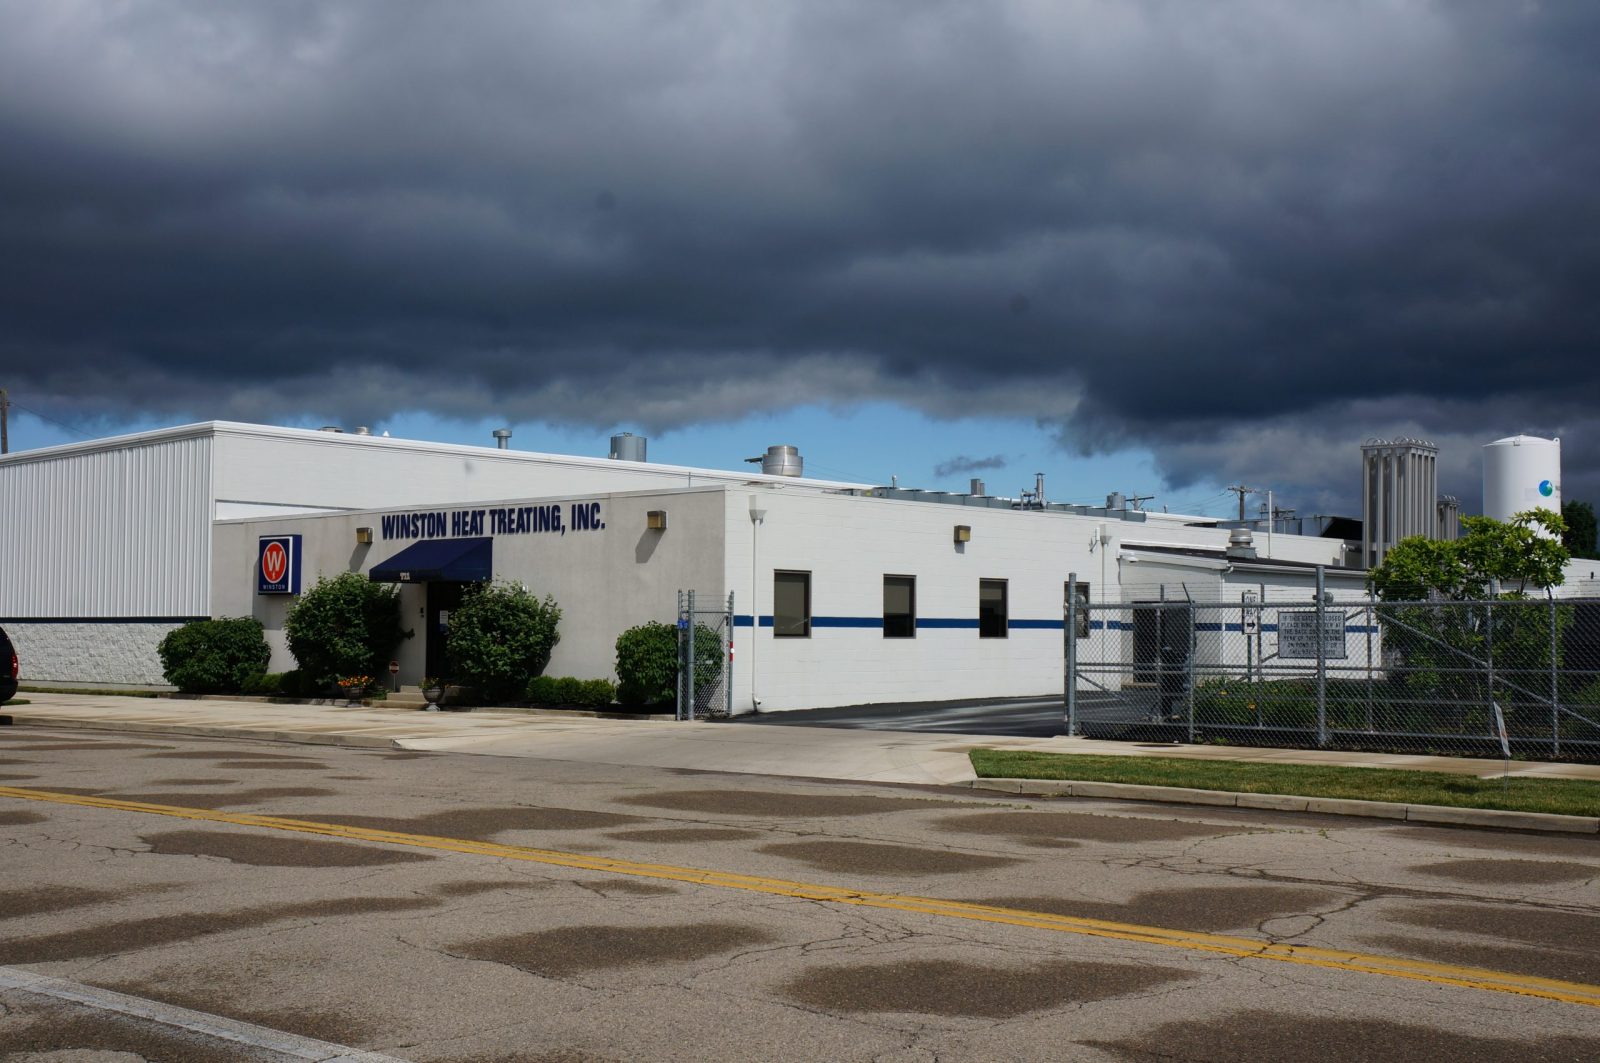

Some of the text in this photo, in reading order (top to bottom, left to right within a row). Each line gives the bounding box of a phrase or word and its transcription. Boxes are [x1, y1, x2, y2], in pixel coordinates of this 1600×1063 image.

[381, 502, 606, 540] WINSTON HEAT TREATING, INC.
[266, 550, 283, 572] W
